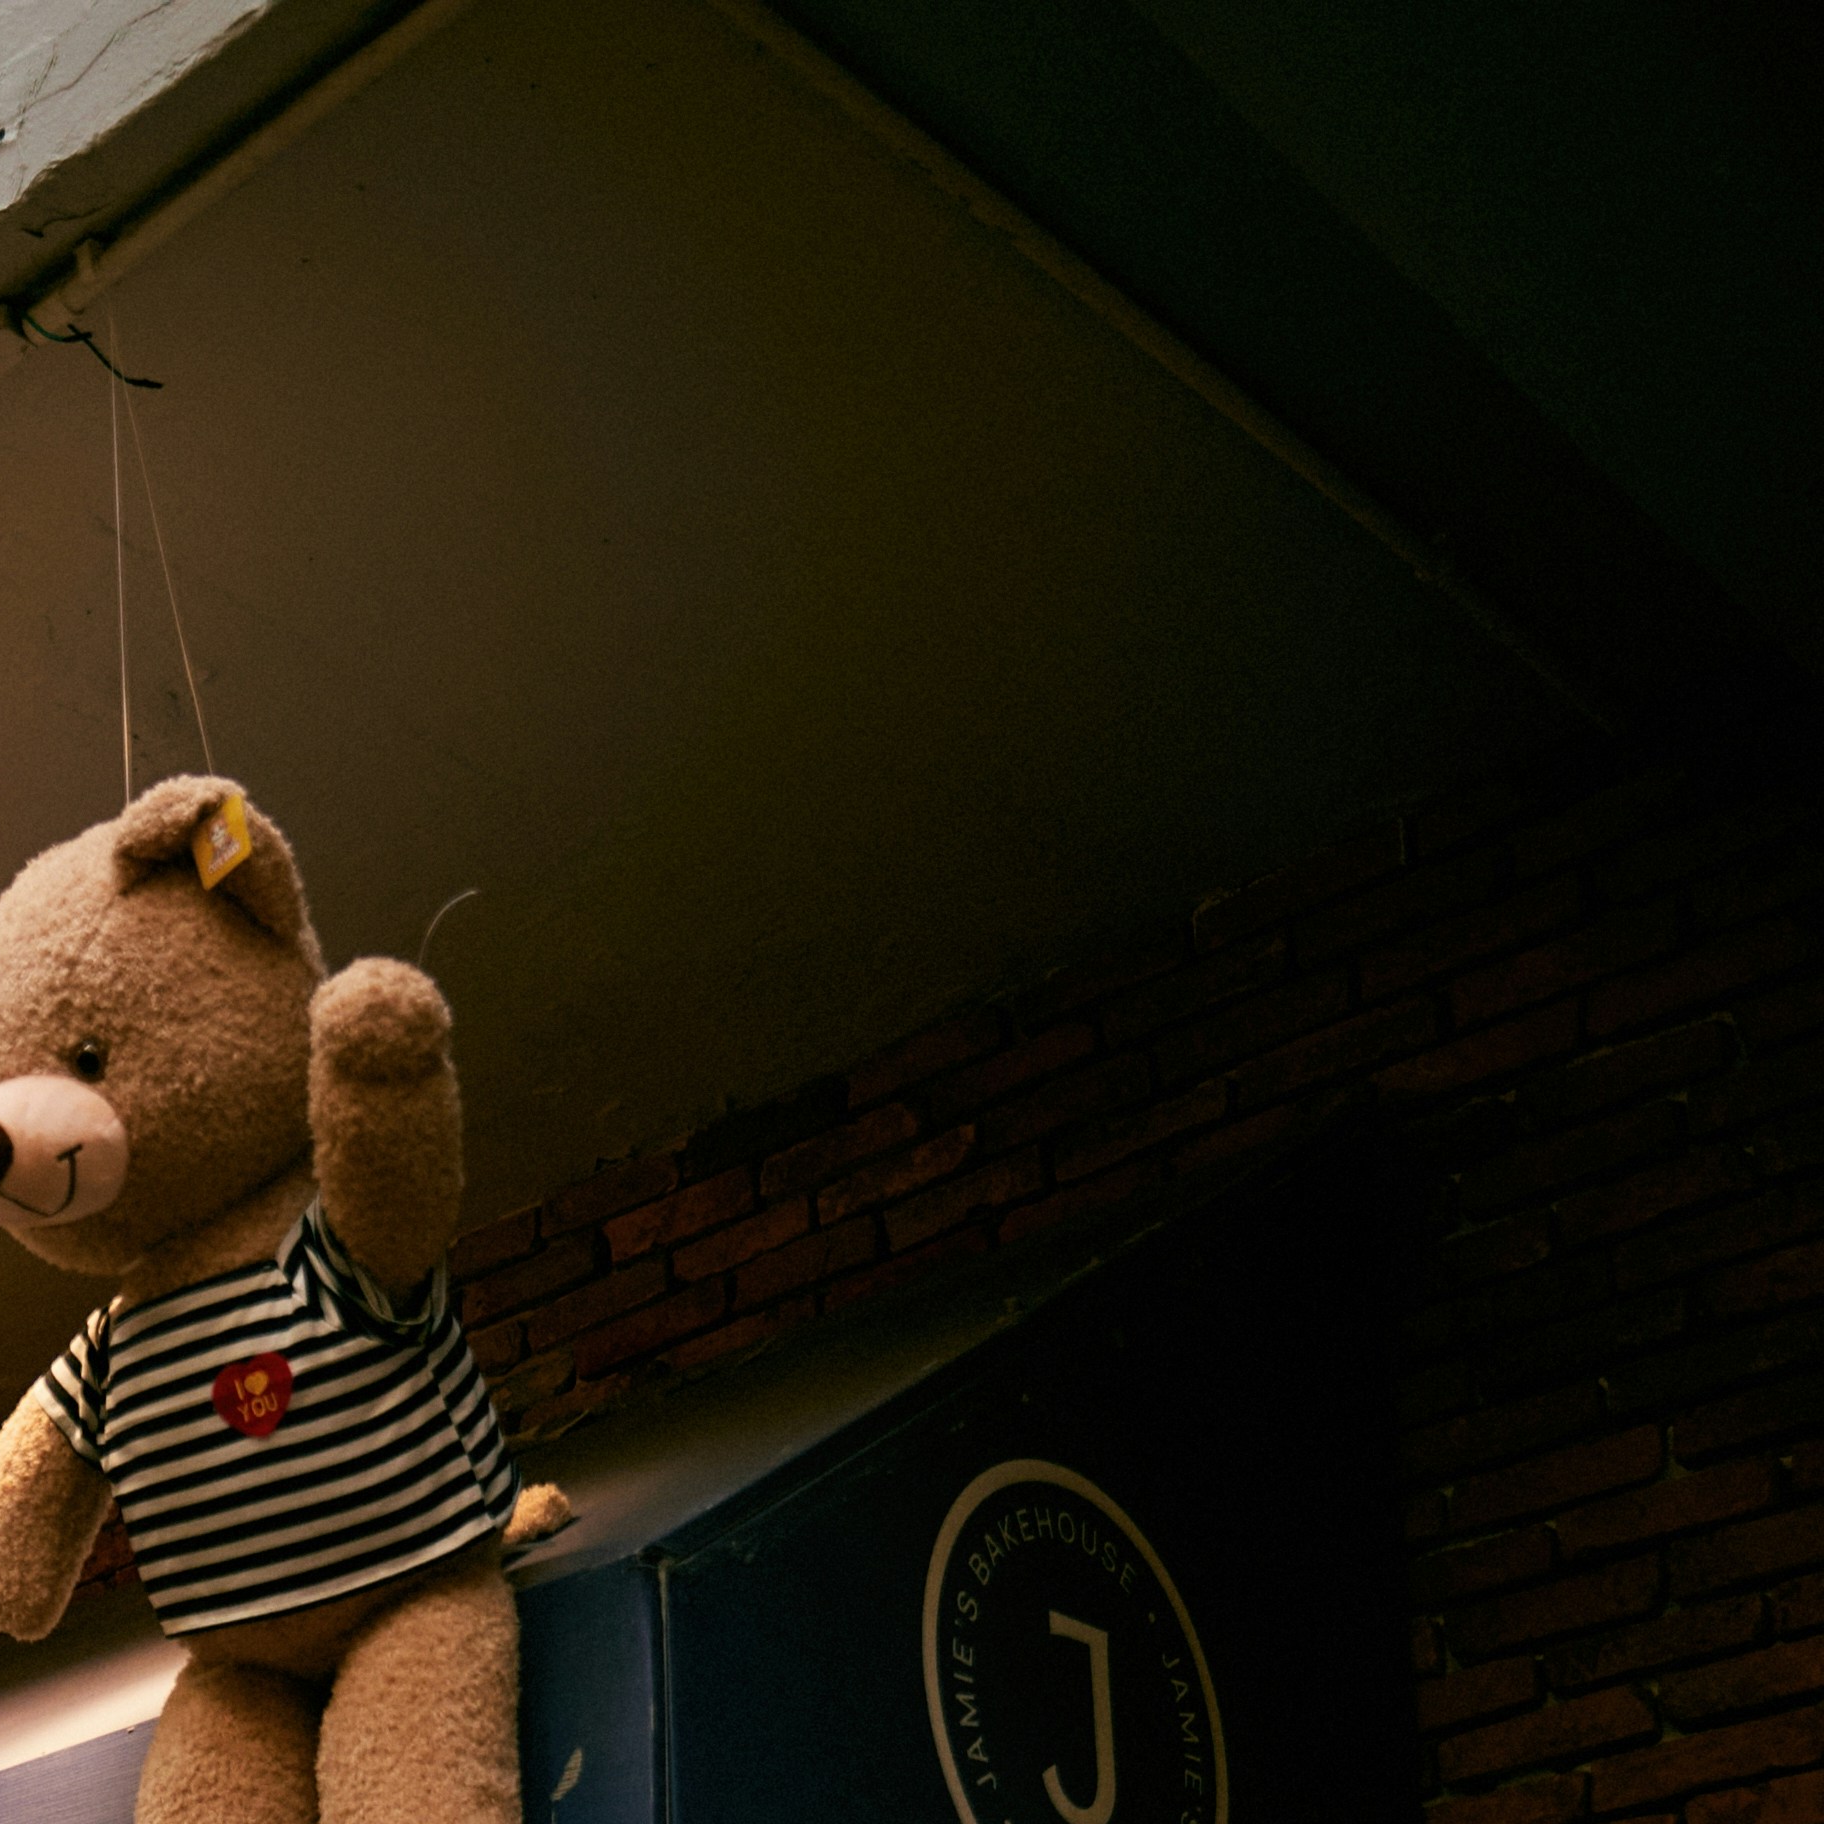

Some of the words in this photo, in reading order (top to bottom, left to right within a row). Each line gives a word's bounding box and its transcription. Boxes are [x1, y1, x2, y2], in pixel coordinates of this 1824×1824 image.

[234, 1379, 245, 1401] I
[236, 1392, 278, 1423] YOU
[968, 1506, 1135, 1595] BAKEHOUSE
[952, 1590, 997, 1789] JAMIE'S
